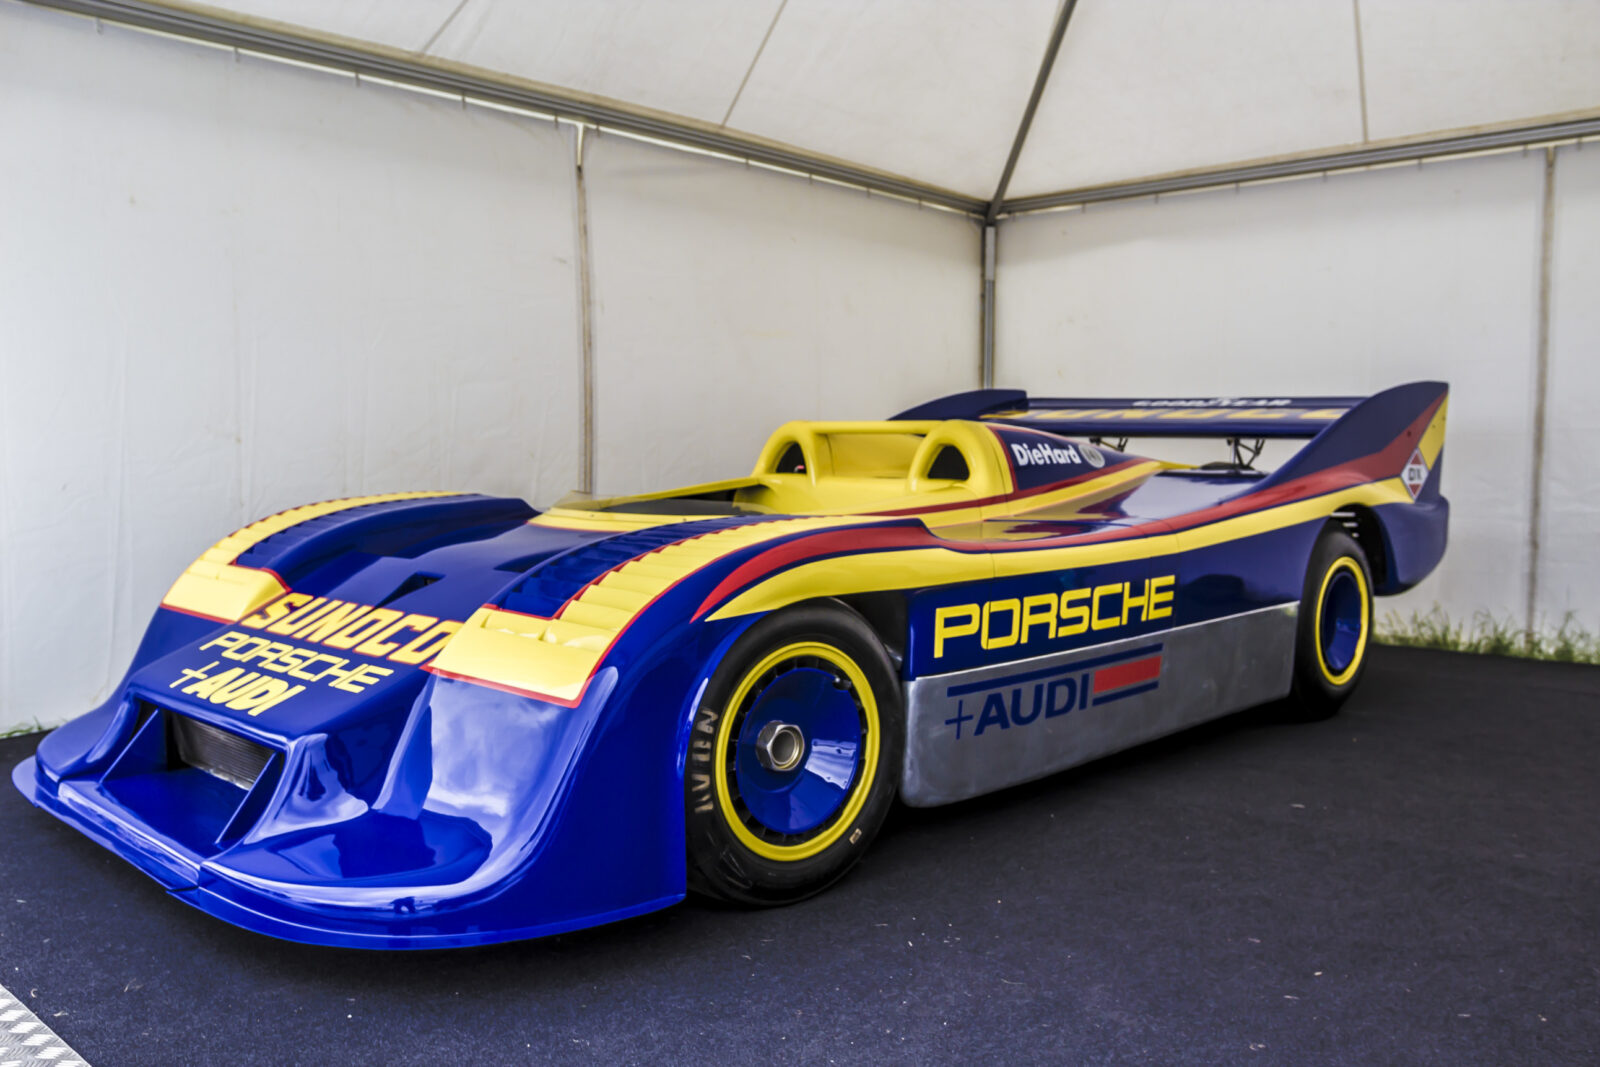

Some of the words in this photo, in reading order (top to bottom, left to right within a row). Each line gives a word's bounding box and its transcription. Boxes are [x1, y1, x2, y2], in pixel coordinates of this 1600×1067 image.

[1010, 442, 1082, 467] DieHard
[240, 592, 466, 666] SUNOCO
[933, 574, 1176, 659] PORSCHE
[199, 630, 395, 694] PORSCHE
